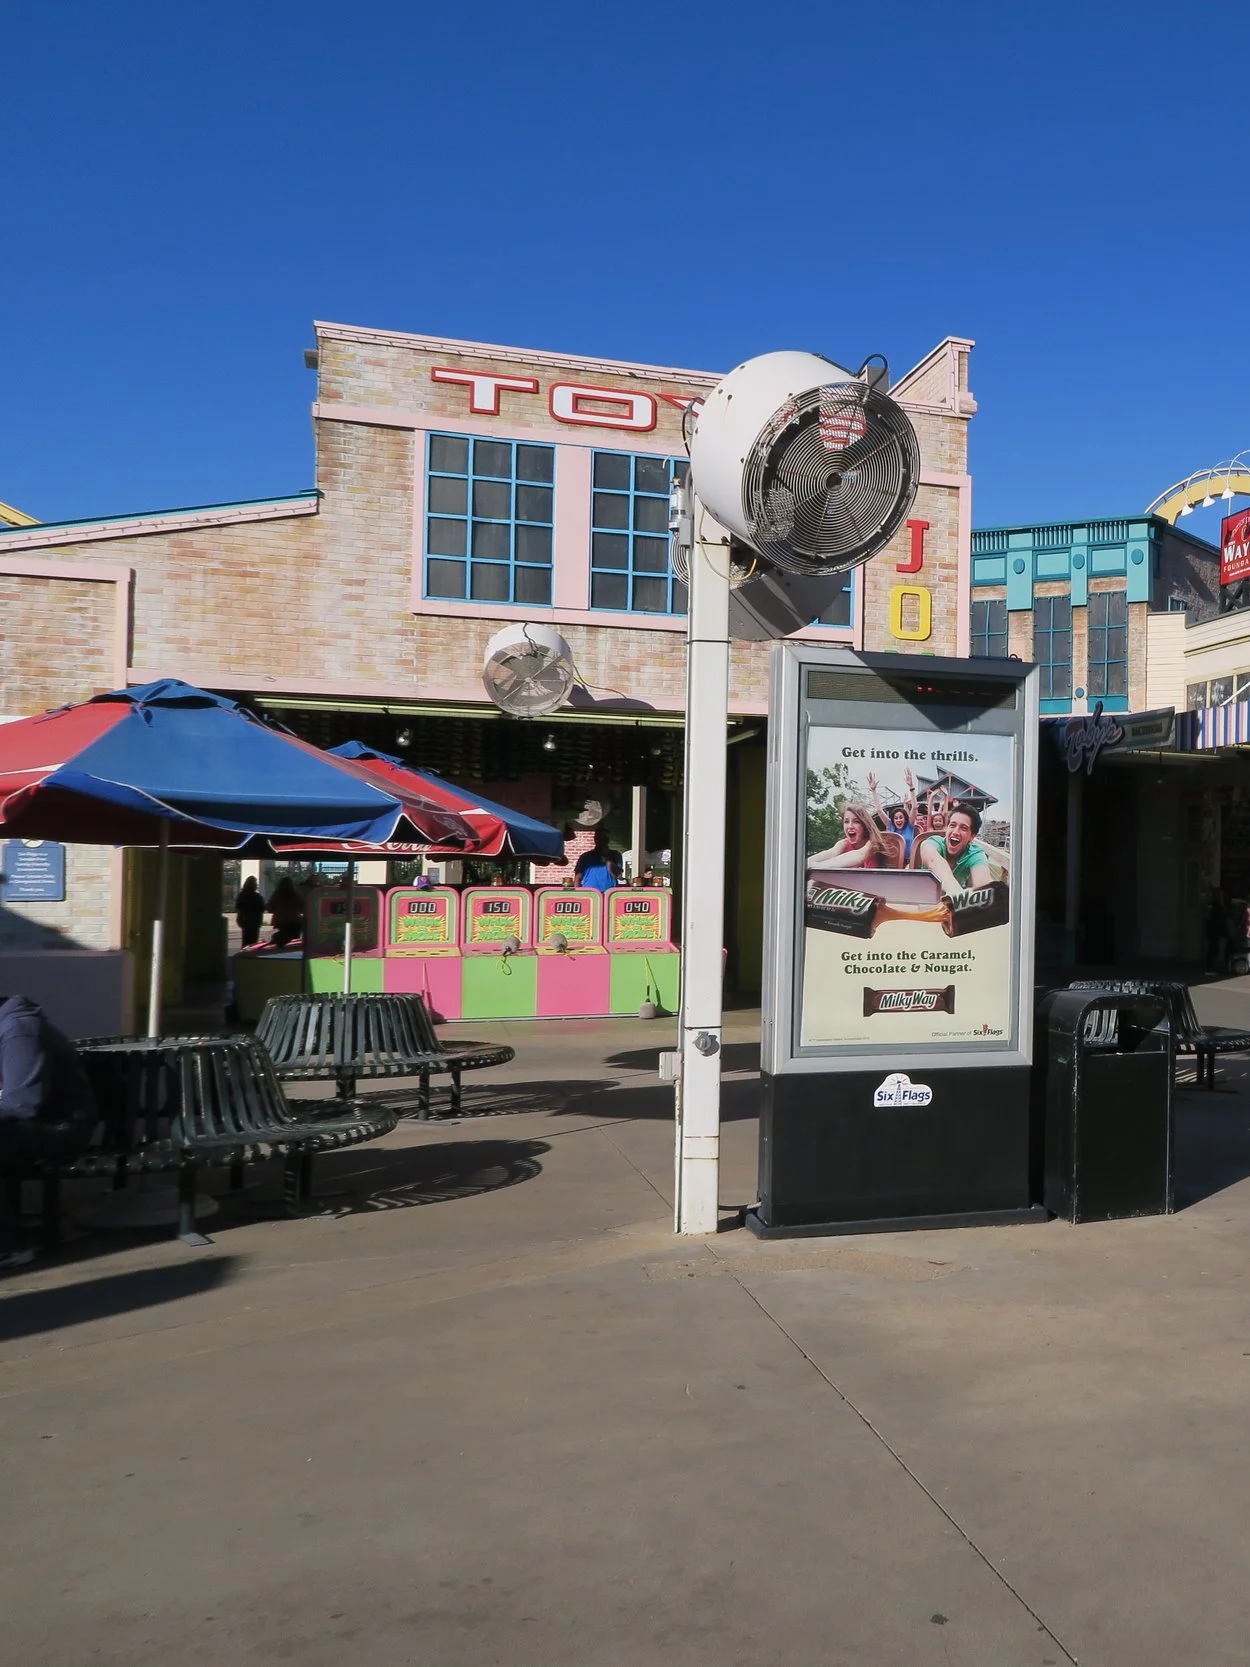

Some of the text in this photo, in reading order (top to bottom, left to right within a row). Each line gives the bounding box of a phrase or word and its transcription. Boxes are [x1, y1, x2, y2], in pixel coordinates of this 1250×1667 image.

[431, 366, 705, 432] TO
[889, 519, 934, 656] JO
[841, 746, 979, 762] Get into the thrills.
[814, 888, 875, 914] Milky
[952, 887, 994, 912] Way
[410, 902, 436, 913] 000
[488, 902, 510, 913] 150
[556, 902, 581, 913] 000
[625, 902, 650, 913] 040
[841, 949, 976, 961] Get into the Caramel,
[844, 963, 973, 975] Chocolate & Nougat.
[986, 1029, 1004, 1037] Flags
[877, 1090, 931, 1102] Six Flags
